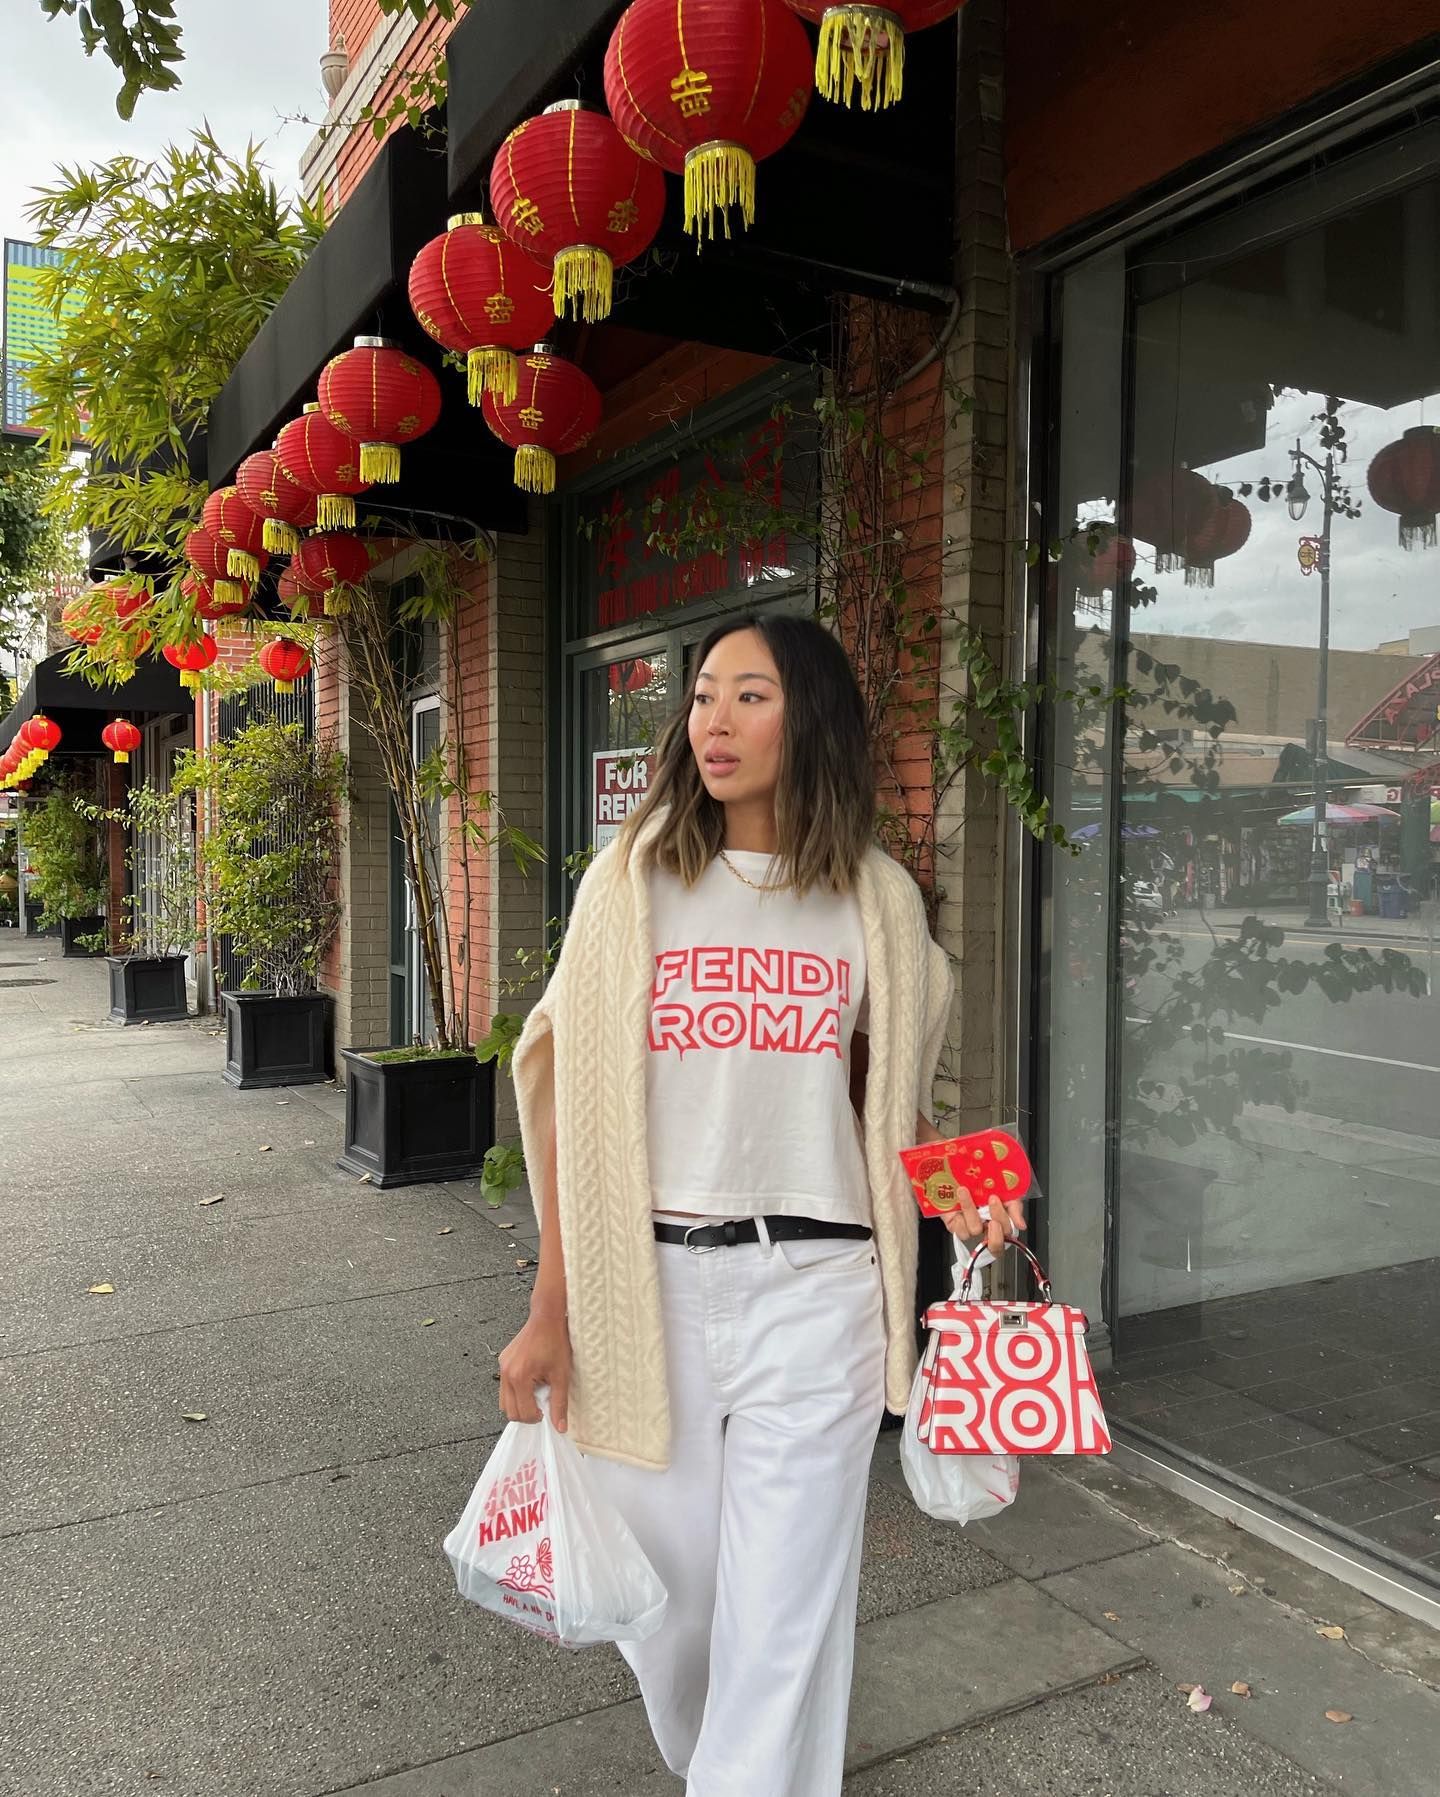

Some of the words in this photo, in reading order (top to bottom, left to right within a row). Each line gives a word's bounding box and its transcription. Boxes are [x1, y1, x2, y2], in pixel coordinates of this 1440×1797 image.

[605, 760, 648, 790] FOR
[598, 792, 648, 821] REN
[653, 947, 850, 1006] FENDI
[649, 1001, 843, 1060] ROMA
